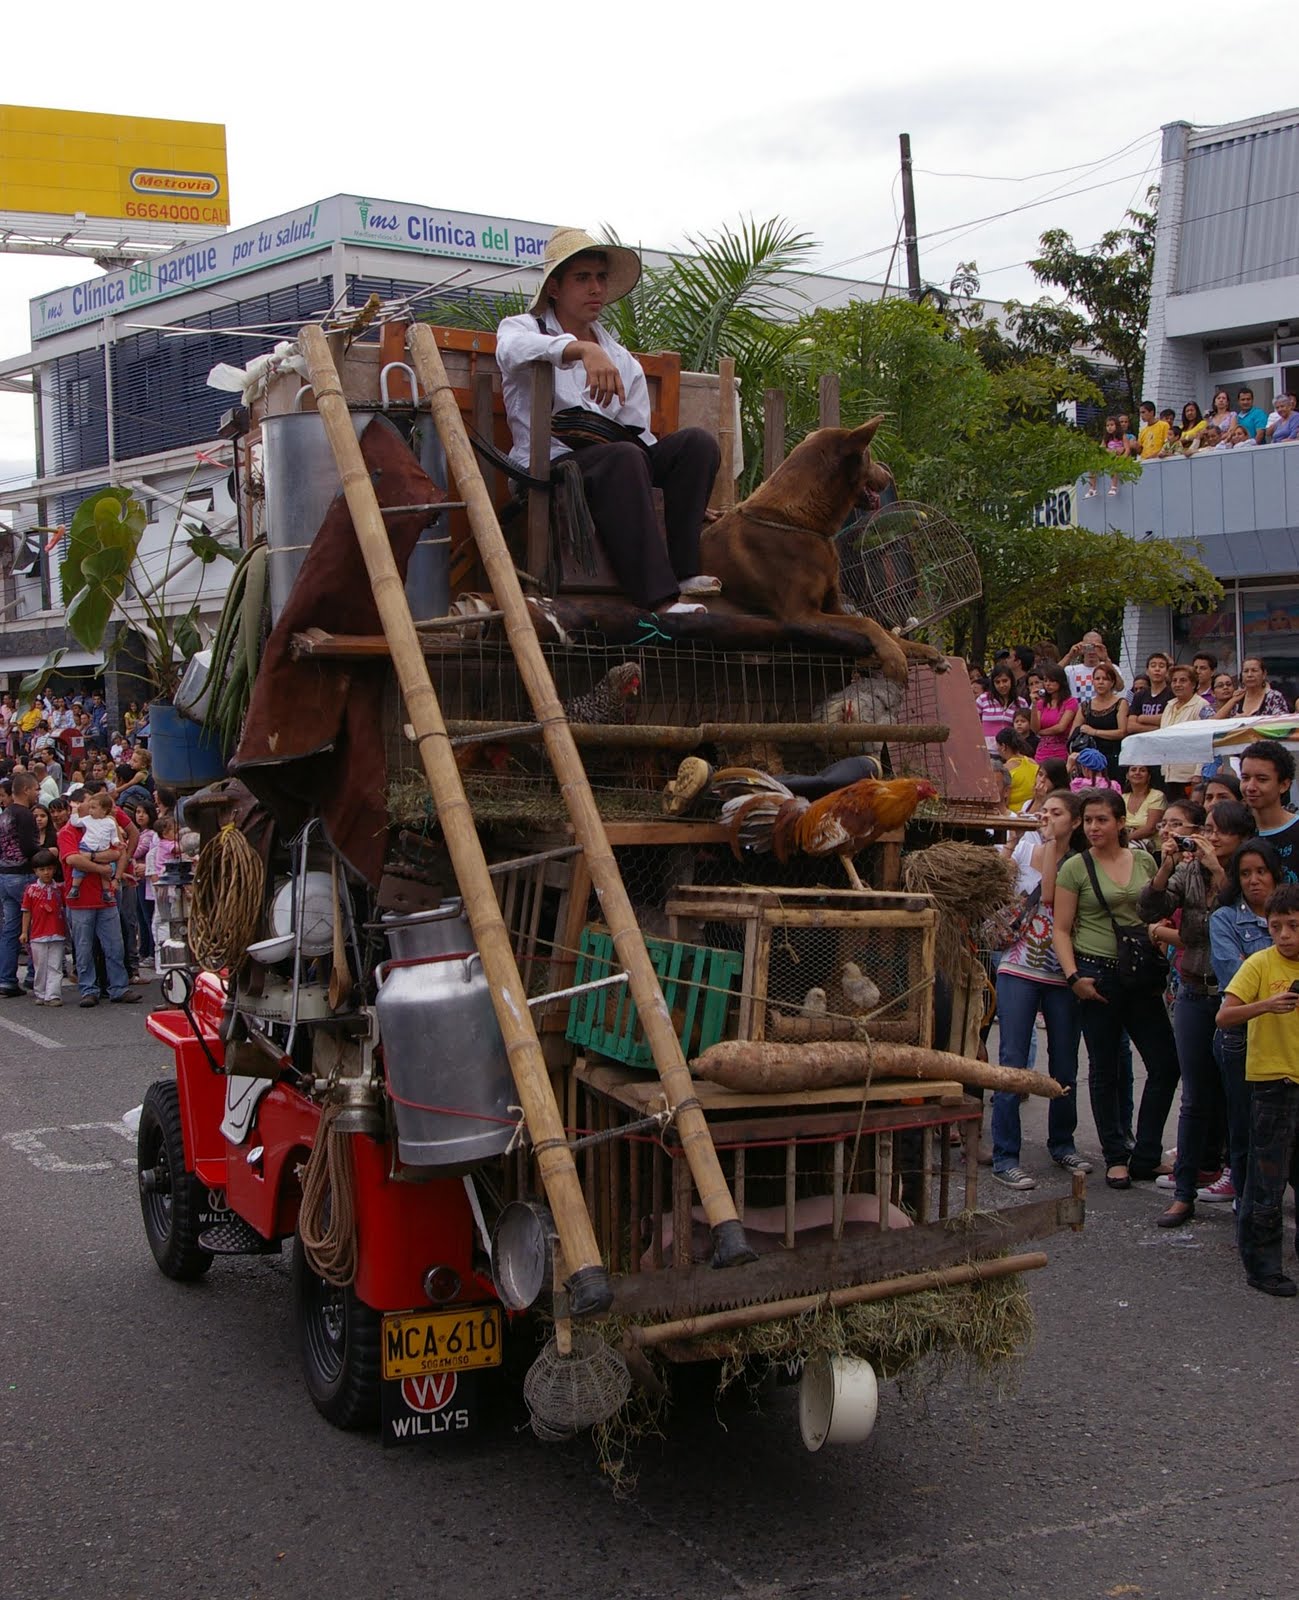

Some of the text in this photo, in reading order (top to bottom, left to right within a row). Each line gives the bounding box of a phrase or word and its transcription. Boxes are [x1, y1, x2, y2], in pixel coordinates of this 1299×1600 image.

[139, 176, 211, 191] Metrovia
[126, 201, 228, 222] 6664000 CALI
[369, 215, 400, 230] ms
[407, 215, 476, 248] Clínica
[482, 226, 509, 251] del
[72, 277, 125, 315] Clínica
[128, 260, 152, 296] del
[158, 247, 217, 293] parque
[232, 238, 255, 266] por
[258, 231, 272, 253] tu
[1142, 703, 1161, 716] FREE
[199, 1212, 240, 1222] WILLY
[421, 1355, 469, 1370] SOGAMOSO
[410, 1371, 449, 1407] W
[391, 1409, 469, 1438] WILLYS
